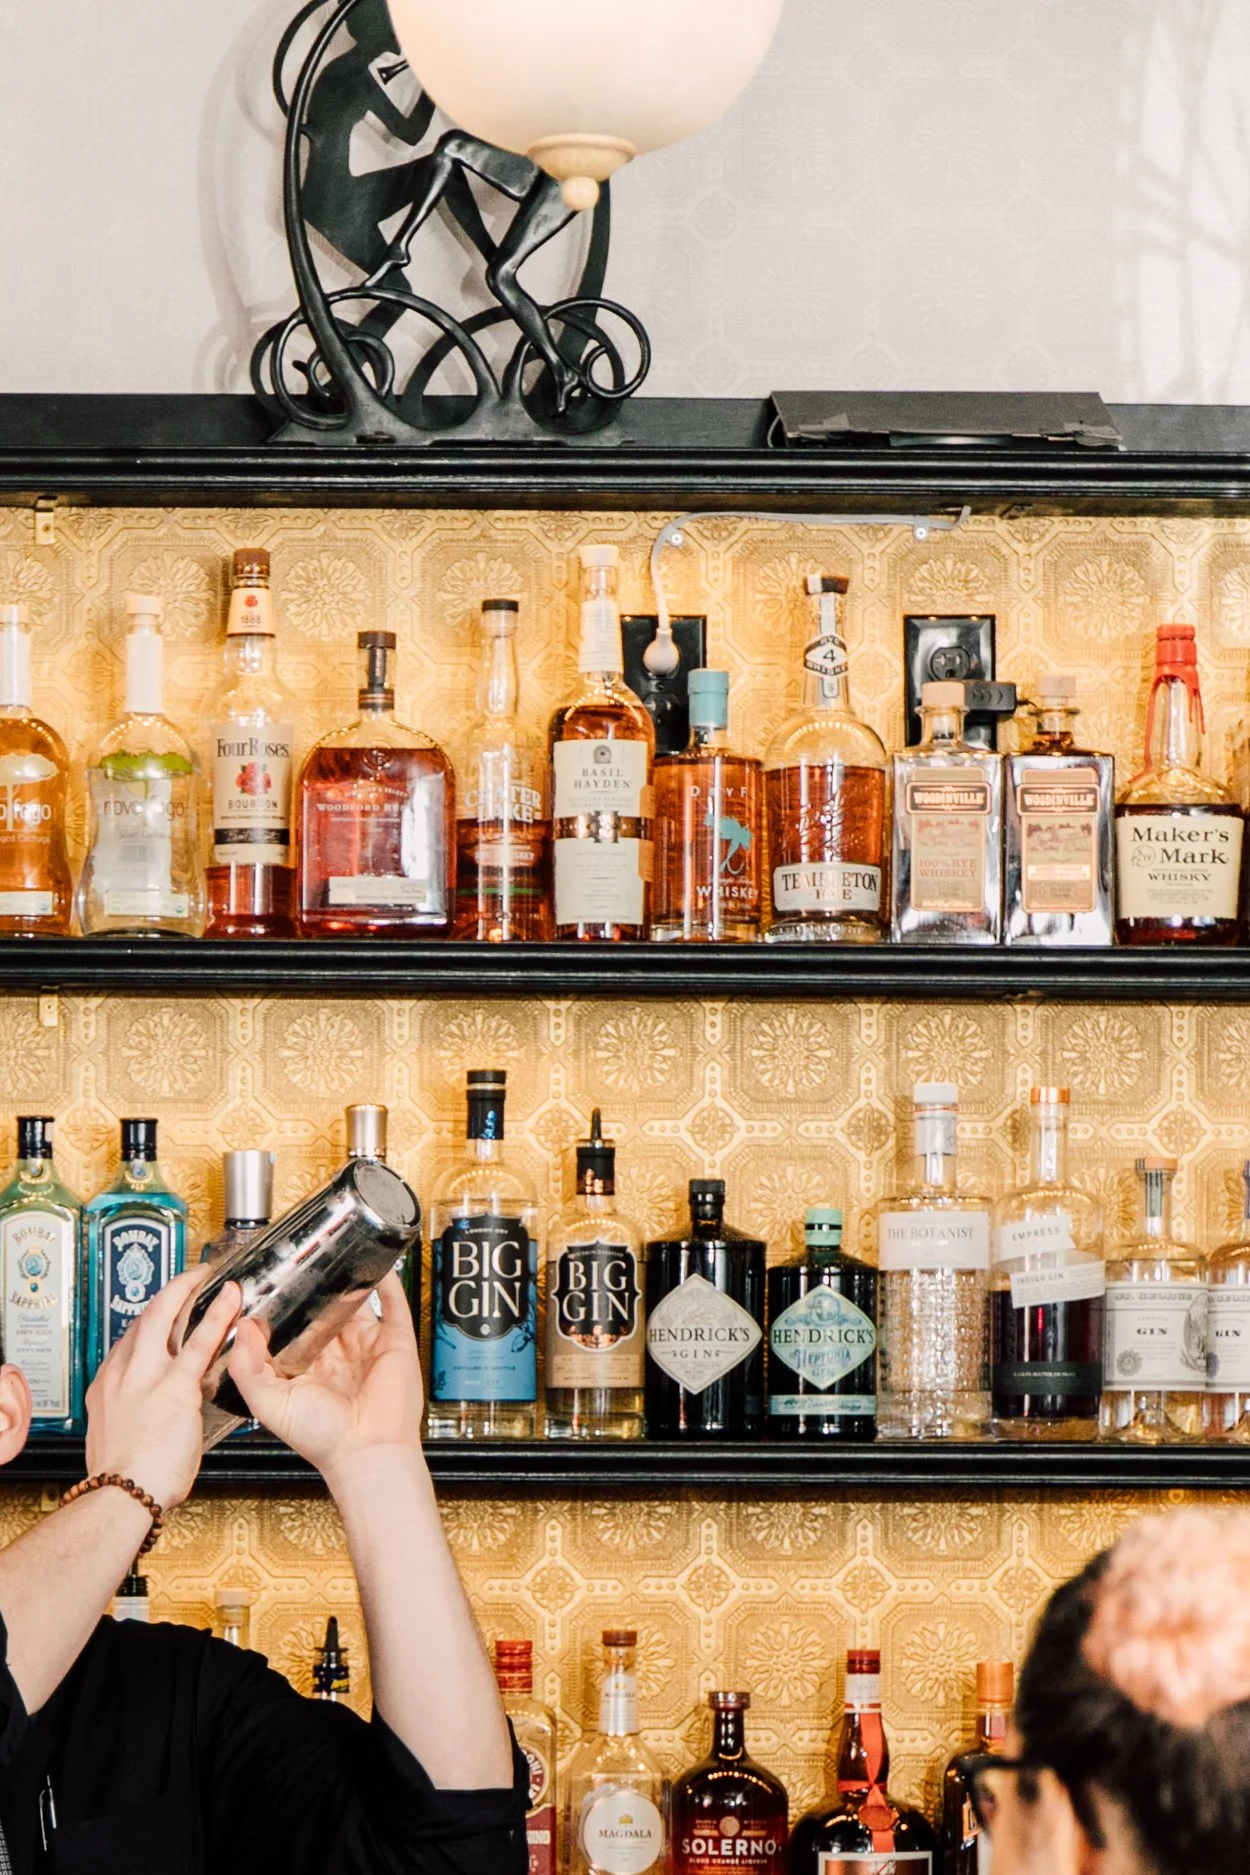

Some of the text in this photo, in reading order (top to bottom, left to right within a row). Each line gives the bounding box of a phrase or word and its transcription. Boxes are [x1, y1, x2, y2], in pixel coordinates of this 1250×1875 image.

[822, 649, 837, 662] 4
[216, 737, 290, 758] Four Roses
[582, 768, 623, 778] BASIL
[574, 779, 631, 789] HAYDEN
[227, 799, 278, 810] BOURON
[913, 791, 986, 805] WOODINVILLE
[1024, 793, 1095, 807] WOODINVILLE
[13, 798, 52, 826] fogo
[316, 802, 381, 812] WOODFORD
[1131, 826, 1230, 843] Maker's
[1159, 847, 1227, 865] Mark
[952, 859, 978, 868] RYE
[919, 868, 977, 878] WHISKEY
[1148, 872, 1212, 881] WHISKY
[696, 885, 759, 898] WHISKEY
[12, 1226, 56, 1246] BOMBAY
[888, 1226, 975, 1240] THE BOTANIST
[1012, 1225, 1061, 1242] EMPRESS
[452, 1241, 522, 1279] BIG
[568, 1260, 627, 1292] BIG
[1016, 1271, 1065, 1285] INDIGO GIN
[448, 1279, 521, 1319] GIN
[562, 1291, 630, 1322] GIN
[649, 1326, 750, 1343] HENDRICK'S
[773, 1327, 875, 1344] HENDRICK'S
[1136, 1327, 1169, 1336] GIN
[1215, 1329, 1242, 1338] GIN
[679, 1348, 713, 1359] GIN
[598, 1828, 652, 1839] MAGDALA
[682, 1837, 777, 1856] SOLERNO
[712, 1857, 740, 1865] ORANGE
